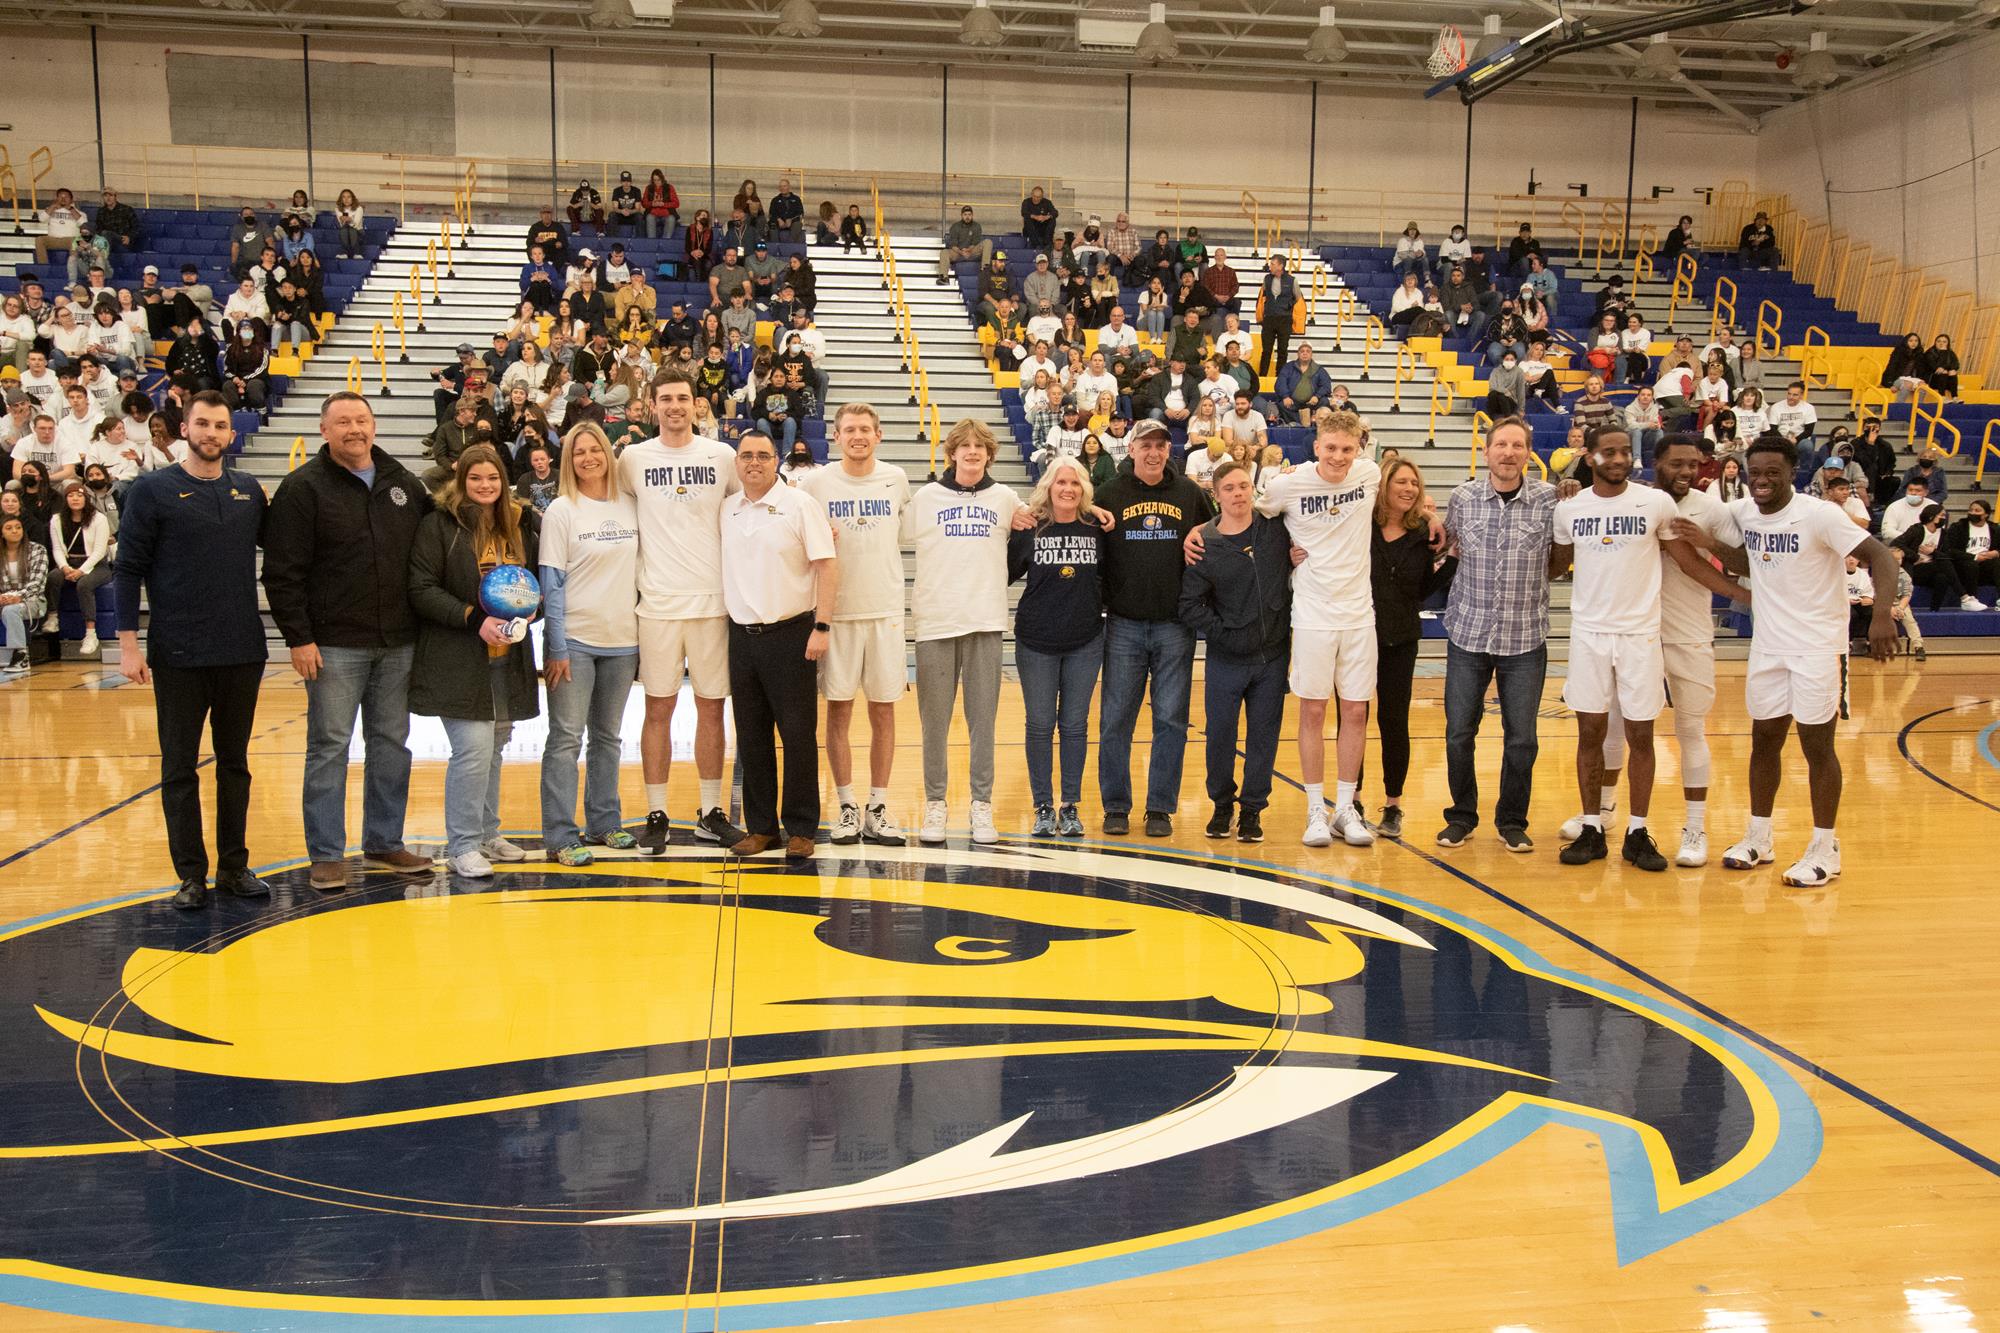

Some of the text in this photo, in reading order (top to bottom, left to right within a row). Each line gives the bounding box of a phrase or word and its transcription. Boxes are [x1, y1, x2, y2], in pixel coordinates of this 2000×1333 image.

[645, 466, 716, 487] FORT LEWIS
[828, 499, 891, 518] FORT LEWIS
[1301, 485, 1365, 515] FORT LEWIS
[937, 506, 998, 526] FORT LEWIS
[1122, 501, 1182, 521] SKYHAWKS
[578, 532, 596, 541] FORT
[598, 530, 617, 538] LEWIS
[945, 523, 991, 538] COLLEGE
[1125, 530, 1178, 541] BASKETBALL
[1572, 516, 1647, 537] FORT LEWIS
[1034, 536, 1096, 550] FORT LEWIS
[1745, 530, 1799, 553] FORT LEWIS
[1034, 549, 1098, 565] COLLEGE
